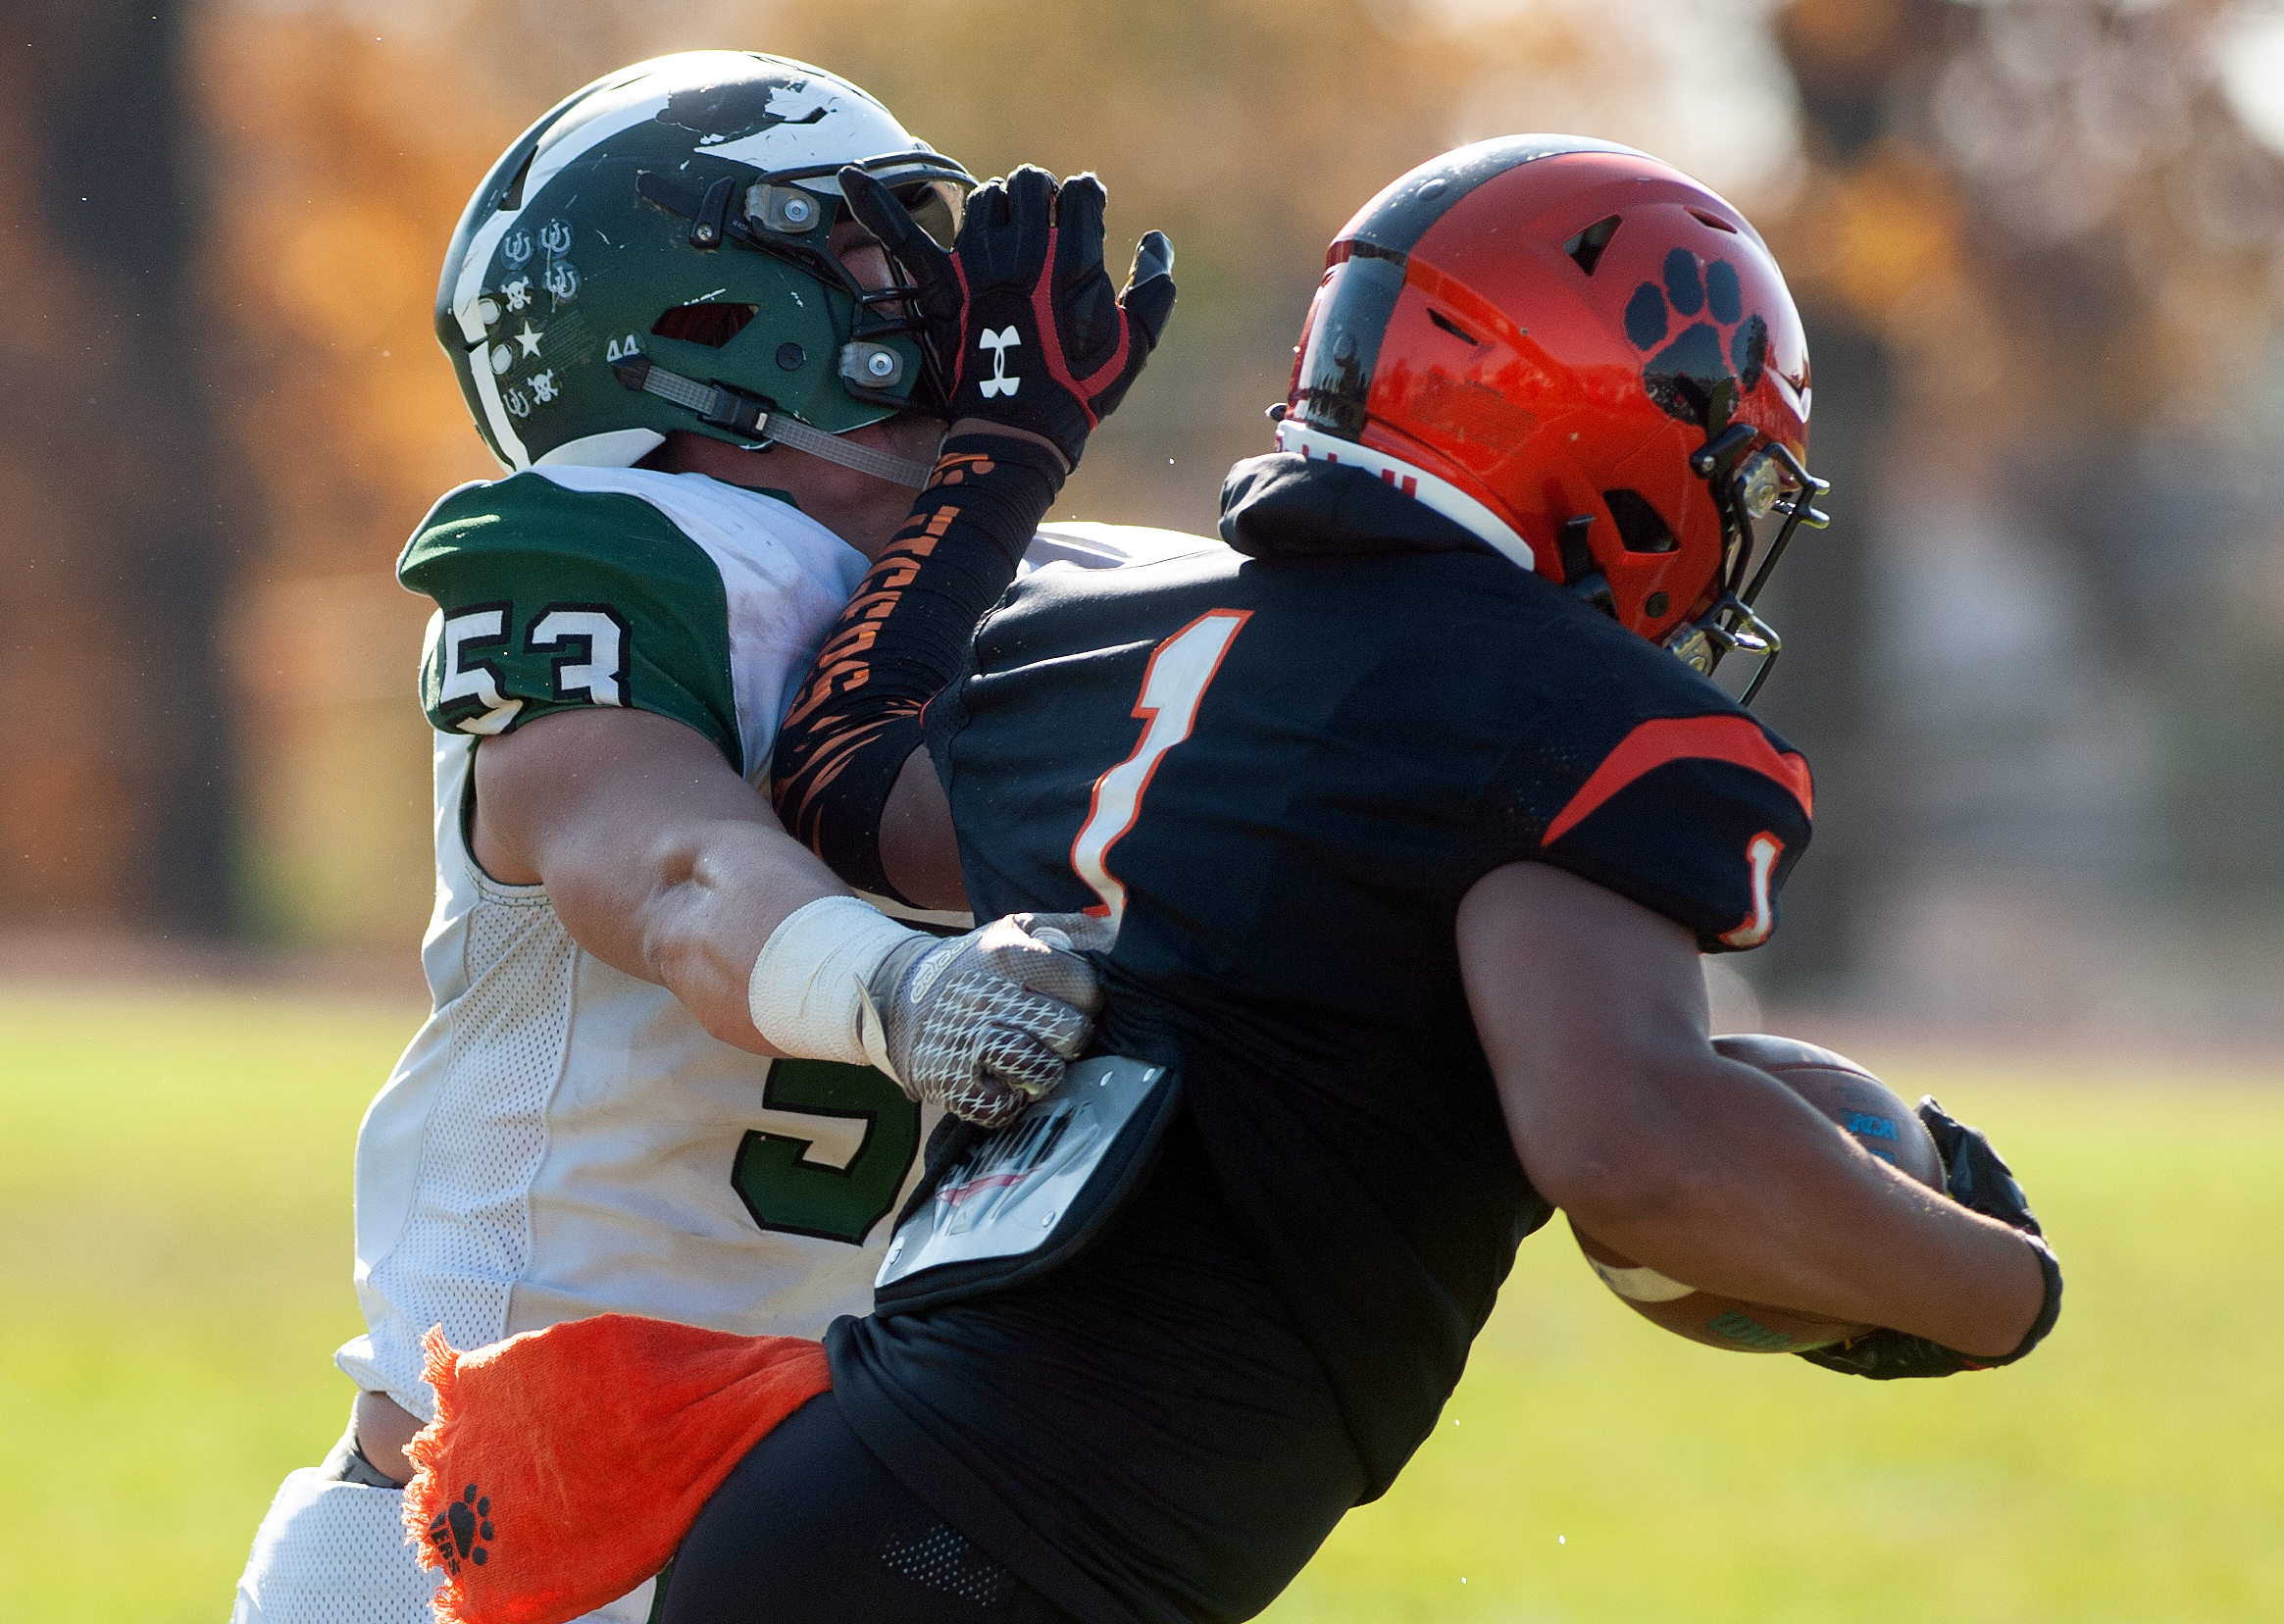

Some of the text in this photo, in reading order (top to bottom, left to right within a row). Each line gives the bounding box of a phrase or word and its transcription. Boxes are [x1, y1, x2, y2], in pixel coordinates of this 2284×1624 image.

[606, 334, 640, 362] 44
[438, 600, 633, 736] 53
[1071, 608, 1254, 922] 1
[1717, 830, 1785, 947] 1
[911, 933, 981, 1002] adida
